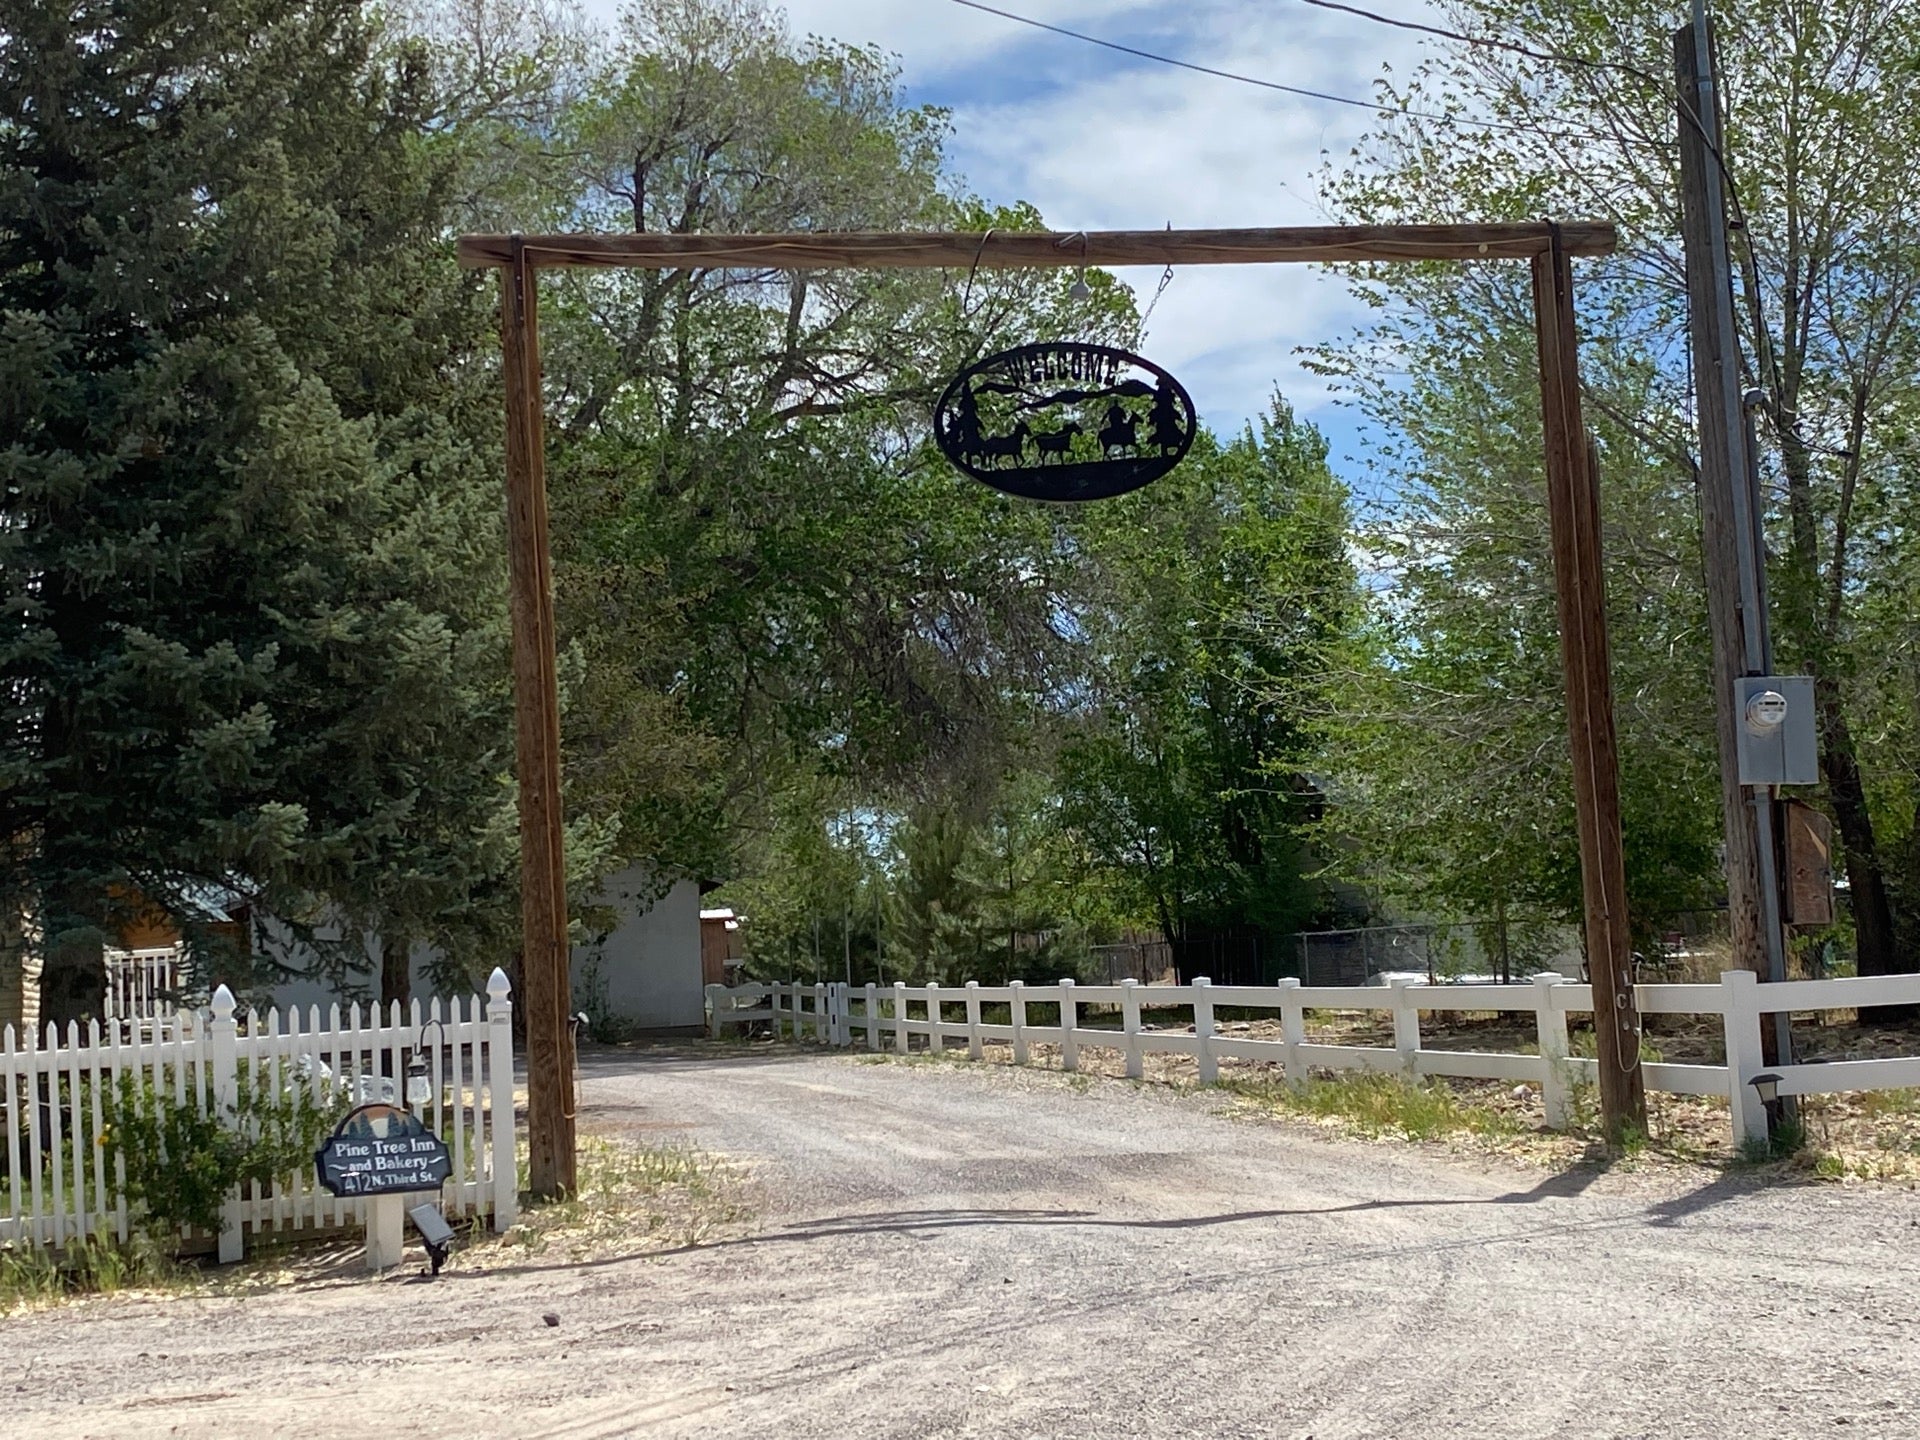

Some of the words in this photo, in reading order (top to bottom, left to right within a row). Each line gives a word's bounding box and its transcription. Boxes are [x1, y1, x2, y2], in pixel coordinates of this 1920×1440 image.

[1008, 350, 1118, 387] WELCOME
[335, 1143, 370, 1157] Pine
[372, 1140, 408, 1154] Tree
[410, 1138, 436, 1152] Inn
[348, 1160, 372, 1172] and
[374, 1155, 428, 1170] Bakery
[344, 1172, 373, 1193] 412
[371, 1174, 385, 1187] N.
[385, 1172, 417, 1185] Third
[420, 1171, 437, 1183] St.
